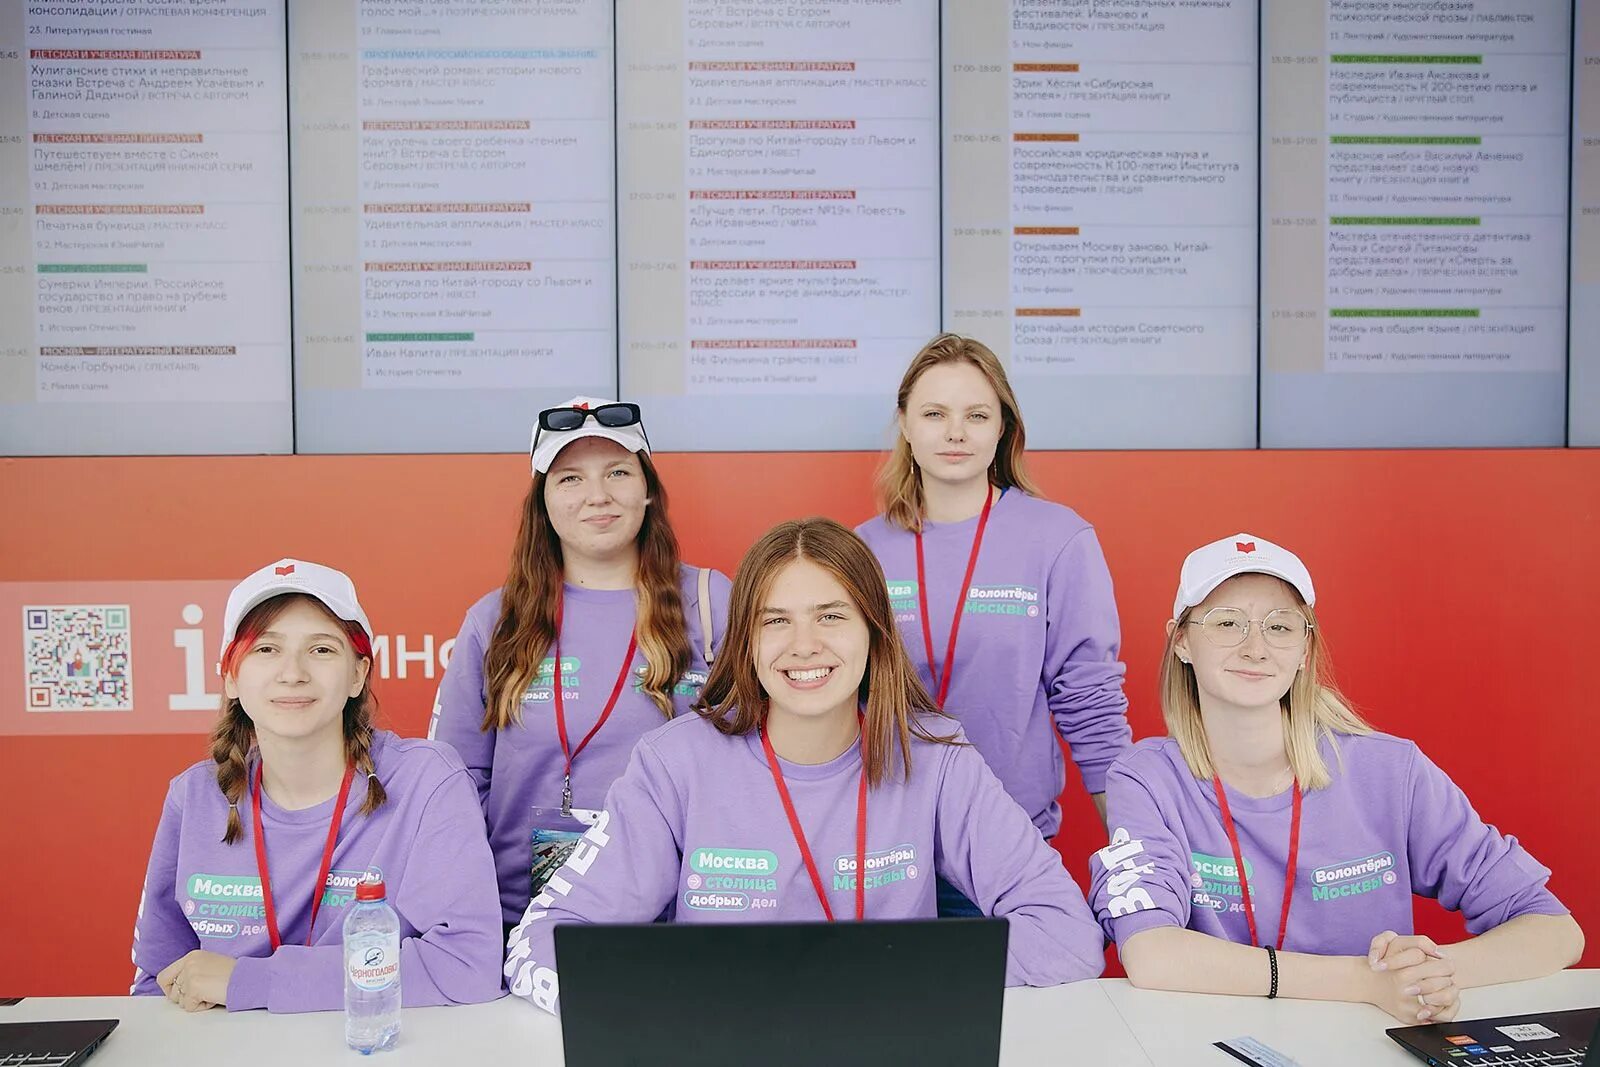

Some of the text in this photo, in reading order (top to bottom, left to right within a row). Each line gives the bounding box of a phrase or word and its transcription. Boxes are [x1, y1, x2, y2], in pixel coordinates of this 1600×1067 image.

[29, 7, 266, 17] консолидации ОТРАСЛЕВАЯ КОНФЕРЕНЦИЯ
[31, 65, 108, 77] Хулиганские
[112, 67, 146, 76] стихи
[161, 67, 248, 77] неправильные
[31, 79, 72, 88] сказки
[76, 78, 125, 89] Встреча
[139, 78, 192, 89] Андреем
[32, 89, 82, 99] Галиной
[37, 220, 93, 230] Печатная
[38, 279, 224, 291] Сумерки Российское
[39, 292, 113, 303] государство
[128, 293, 162, 303] право
[39, 305, 73, 313] веков
[970, 588, 1037, 601] Волонтёры
[965, 602, 1026, 616] Москвы
[698, 852, 769, 871] Москва
[1315, 857, 1392, 884] Волонтёры
[193, 879, 263, 897] Москва
[705, 876, 777, 891] столица
[1312, 878, 1383, 901] Москвы
[690, 894, 777, 908] добрых дел
[193, 920, 234, 934] обрых
